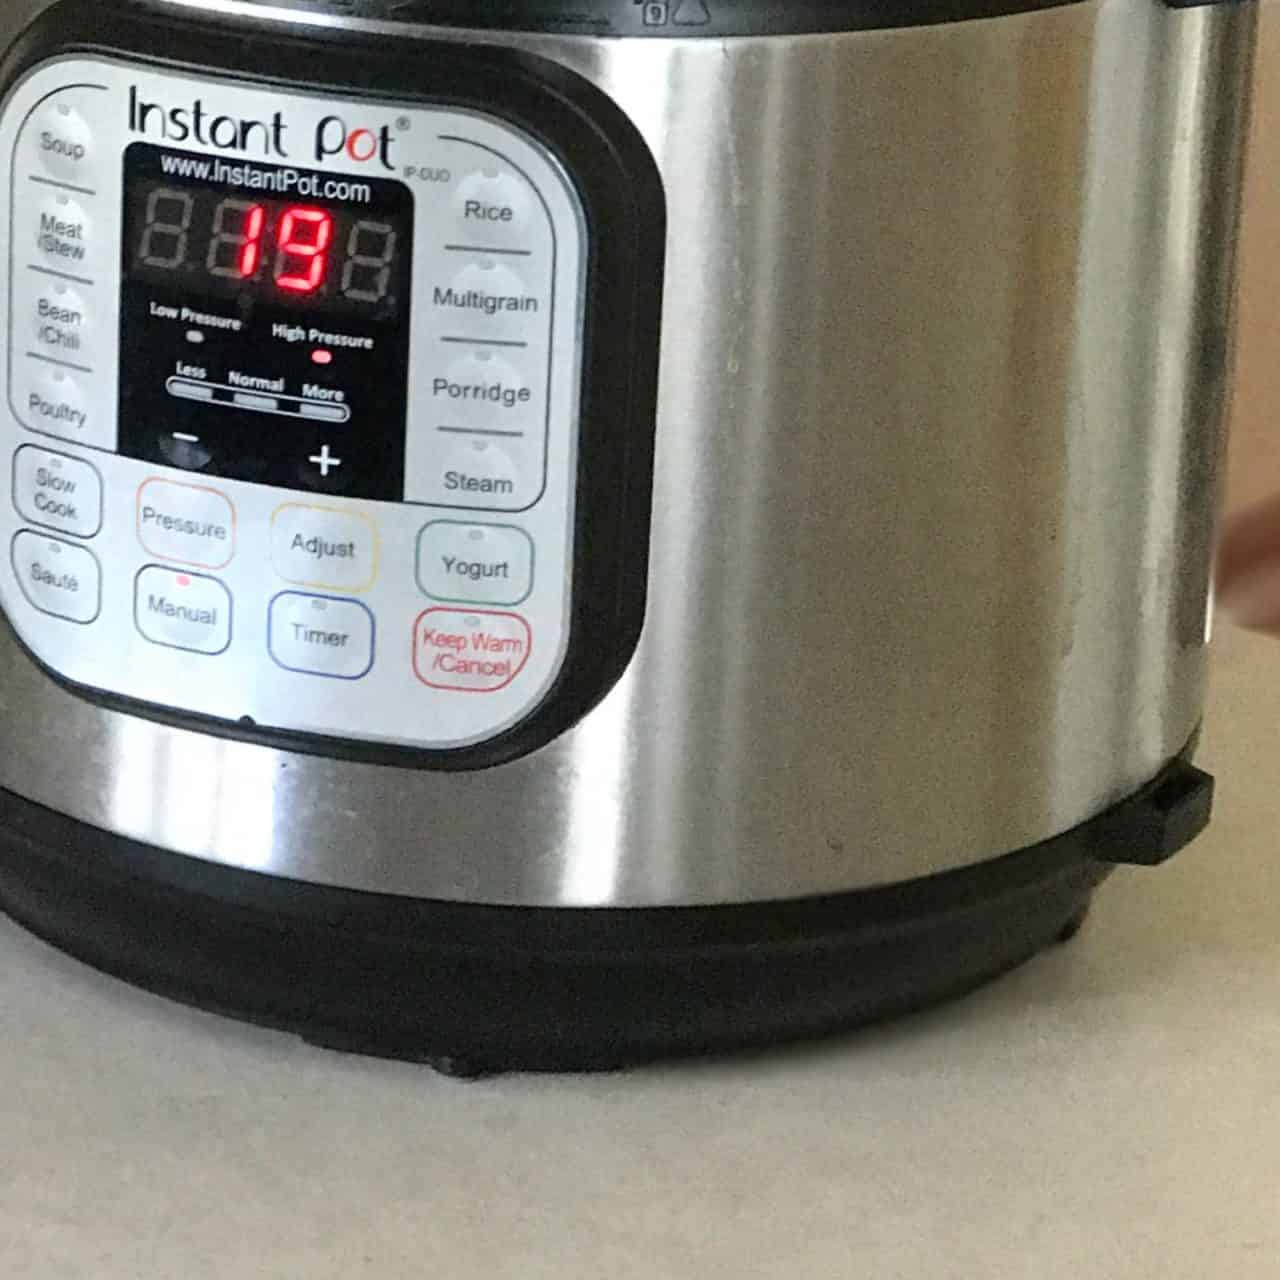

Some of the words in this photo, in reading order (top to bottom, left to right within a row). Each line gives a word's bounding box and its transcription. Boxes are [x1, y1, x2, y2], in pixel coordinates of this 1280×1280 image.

[128, 84, 289, 158] Instant
[314, 114, 396, 170] Pot
[39, 130, 86, 161] Soup
[160, 152, 371, 204] www.InstantPot.com
[464, 200, 513, 222] Rice
[39, 212, 84, 240] Meat
[37, 298, 82, 324] Bean
[433, 286, 539, 314] Multigrain
[149, 301, 178, 318] Low
[181, 307, 242, 331] Pressure
[272, 323, 305, 343] High
[308, 327, 374, 349] Pressure
[175, 360, 207, 379] Less
[228, 371, 285, 392] Normal
[302, 384, 345, 402] More
[433, 377, 531, 408] Porridge
[28, 393, 87, 429] Poultry
[35, 467, 76, 495] Slow
[444, 471, 513, 494] Steam
[33, 492, 78, 519] Cook
[142, 506, 227, 540] Pressure
[291, 532, 355, 560] Adjust
[441, 556, 509, 580] Yogurt
[147, 594, 218, 626] Manual
[291, 623, 350, 648] Timer
[423, 628, 467, 652] Keep
[472, 632, 522, 654] Warm
[432, 653, 511, 678] /Cancel
